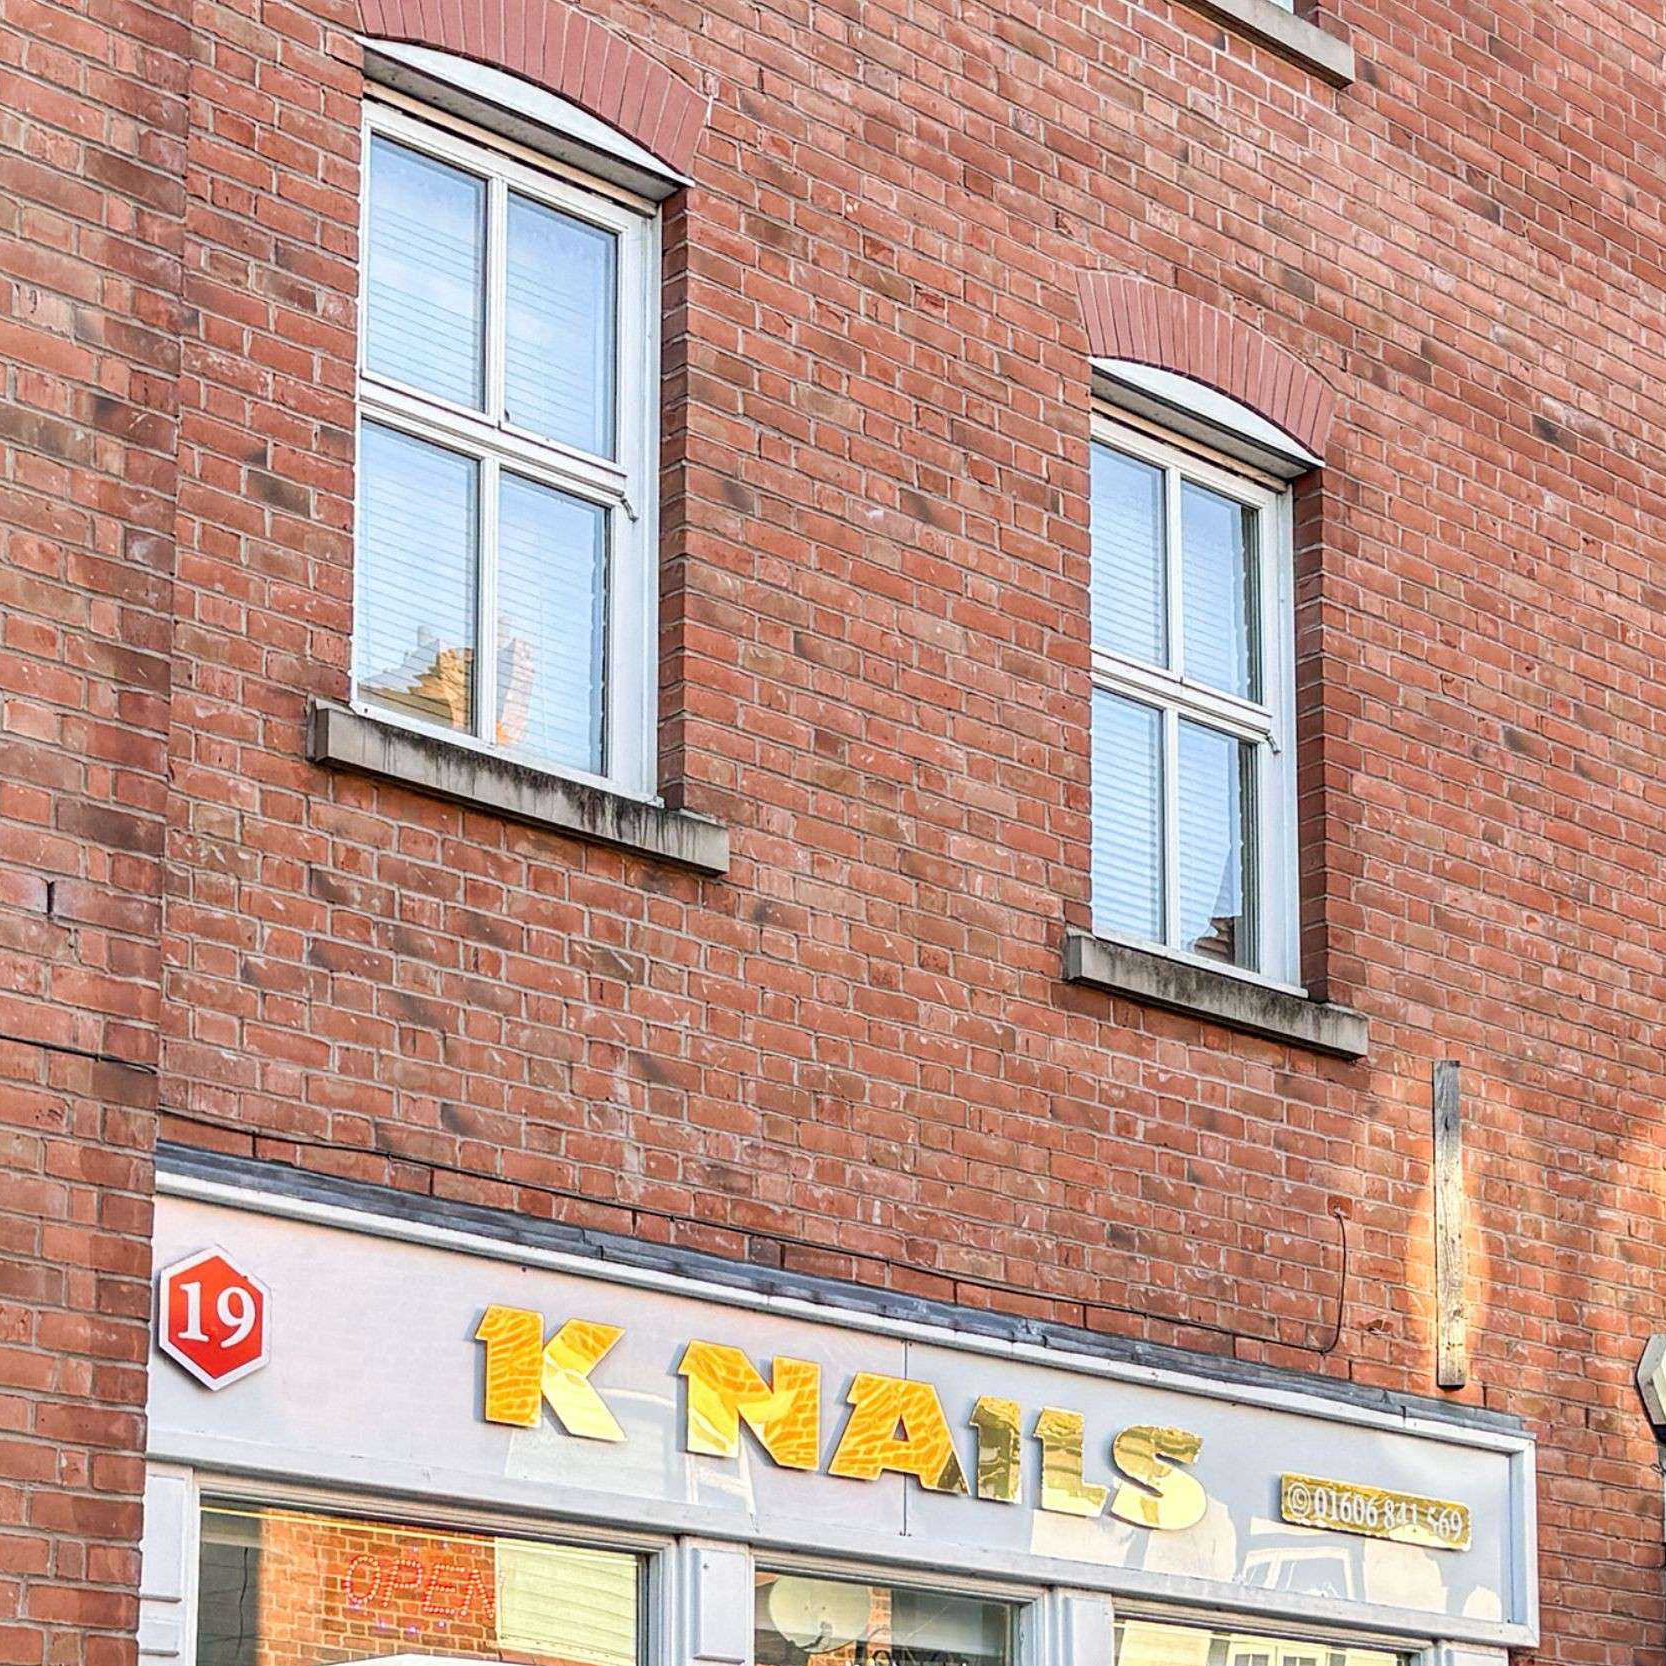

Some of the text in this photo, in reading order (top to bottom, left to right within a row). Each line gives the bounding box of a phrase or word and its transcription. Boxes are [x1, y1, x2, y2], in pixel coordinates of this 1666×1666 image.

[177, 1279, 253, 1346] 19
[475, 1304, 1207, 1530] K NAILS
[1313, 1488, 1379, 1527] 01606
[344, 1552, 506, 1621] OPEN
